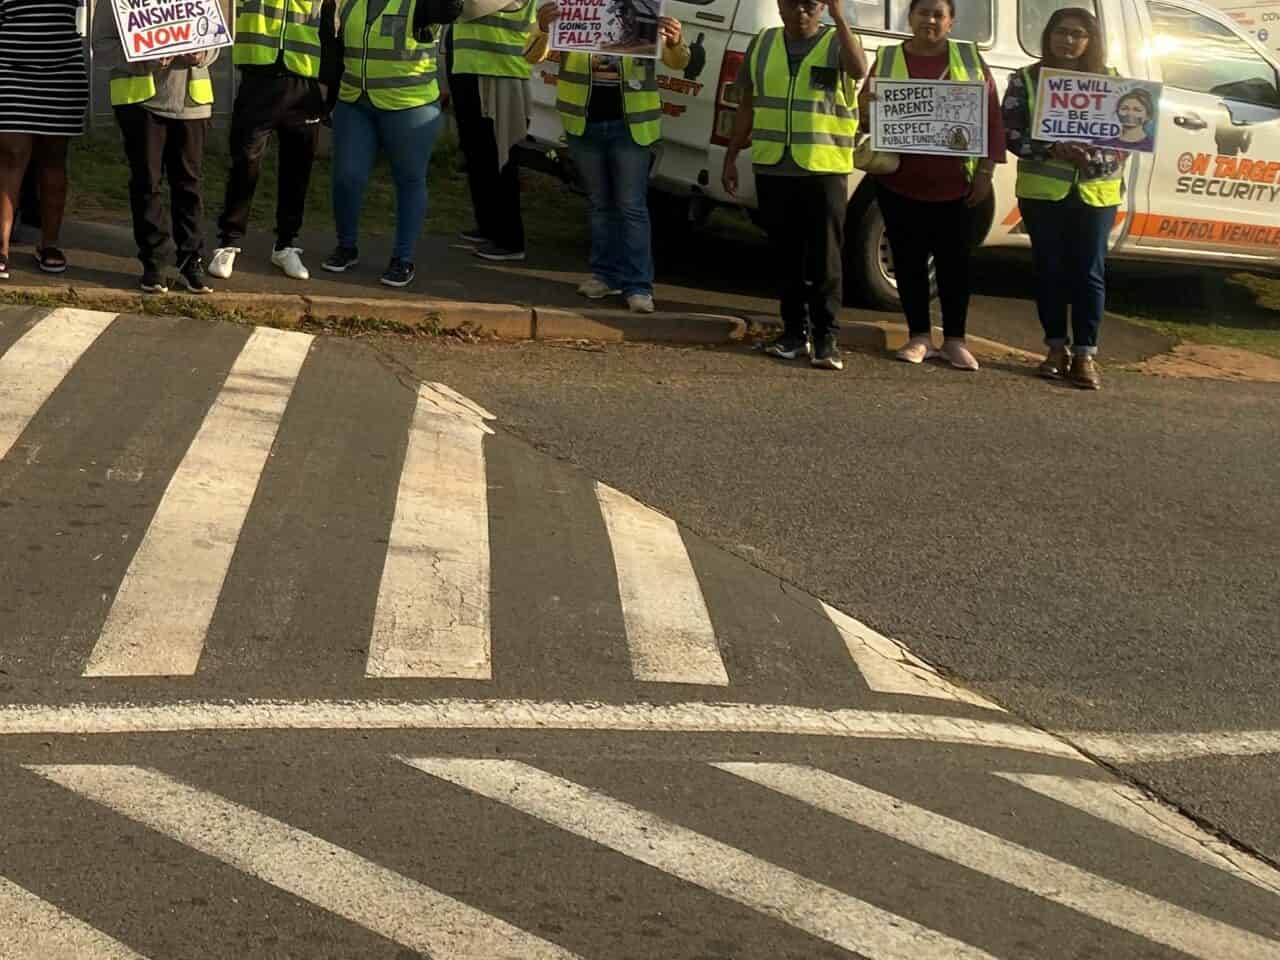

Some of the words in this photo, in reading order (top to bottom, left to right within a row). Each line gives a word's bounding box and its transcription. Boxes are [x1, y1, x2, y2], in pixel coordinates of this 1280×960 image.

[128, 1, 205, 32] ANSWERS
[560, 7, 601, 21] HALL
[559, 22, 588, 31] GOING
[590, 22, 601, 30] TO
[133, 23, 191, 53] NOW
[559, 31, 603, 44] FALL?
[1048, 79, 1072, 91] WE
[1077, 79, 1112, 93] WILL
[884, 87, 934, 102] RESPECT
[1050, 93, 1106, 111] NOT
[883, 100, 934, 117] PARENTS
[1068, 110, 1089, 120] BE
[883, 122, 931, 135] RESPECT
[1041, 119, 1121, 137] SILENCED
[1158, 219, 1214, 240] PATROL
